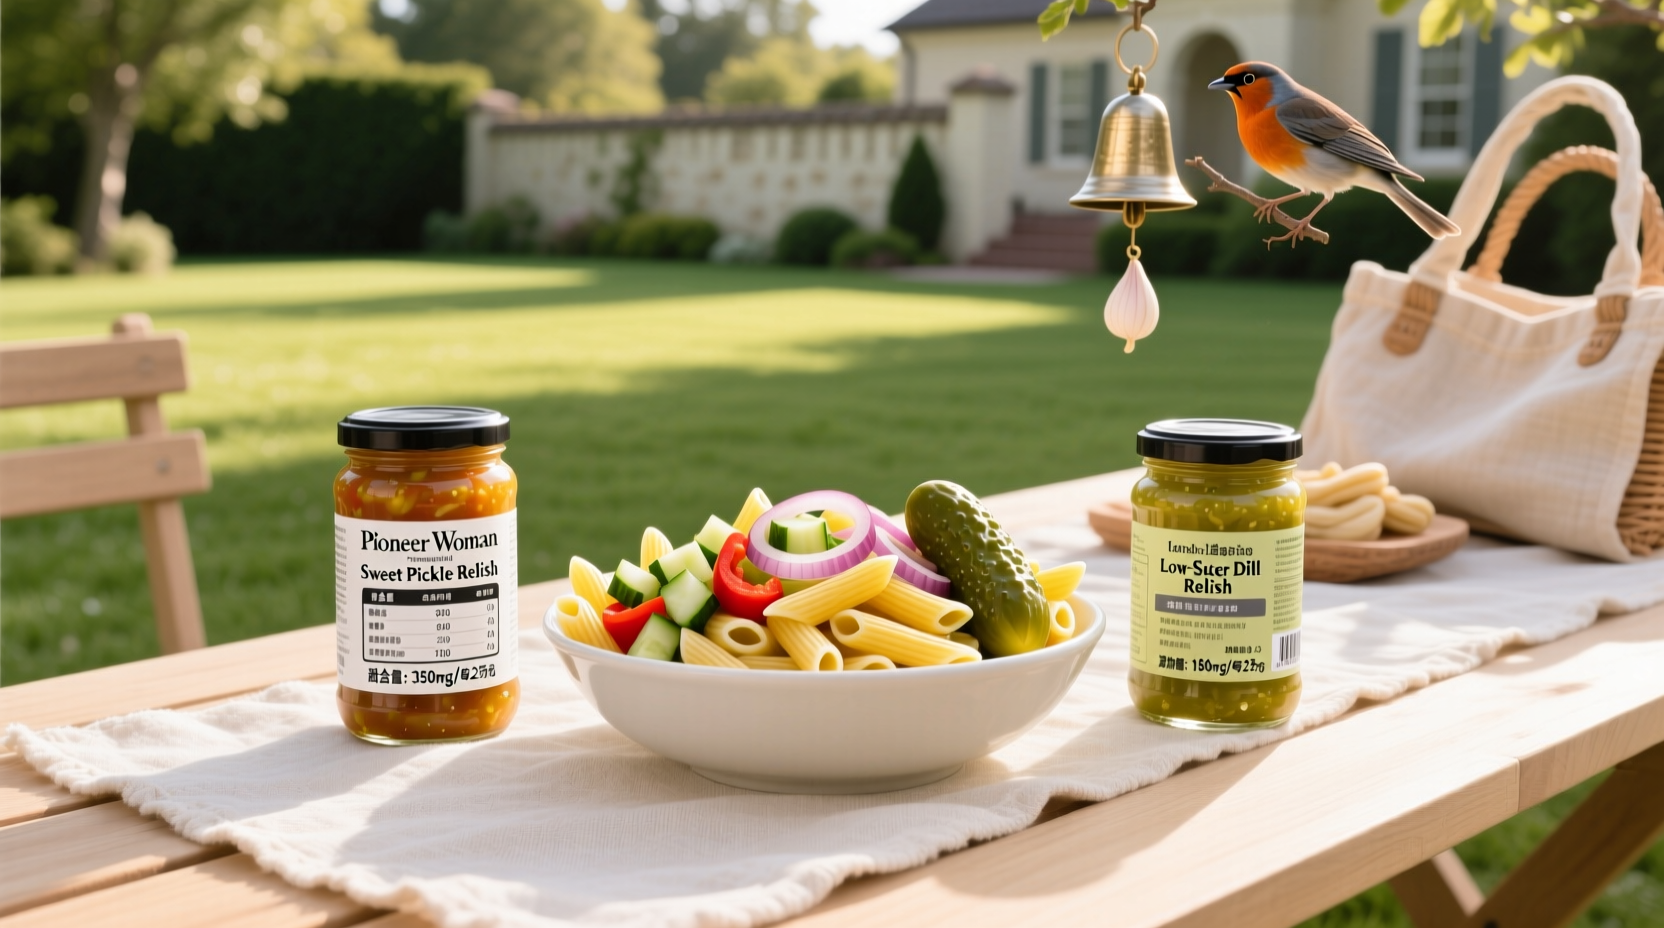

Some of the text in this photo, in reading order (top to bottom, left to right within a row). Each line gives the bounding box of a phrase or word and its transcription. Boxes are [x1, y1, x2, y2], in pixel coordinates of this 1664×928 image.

[360, 529, 498, 552] Pioneer Woman
[360, 560, 498, 582] Sweet Pickle Relish
[1233, 560, 1261, 577] Dill
[1184, 578, 1232, 594] Relish
